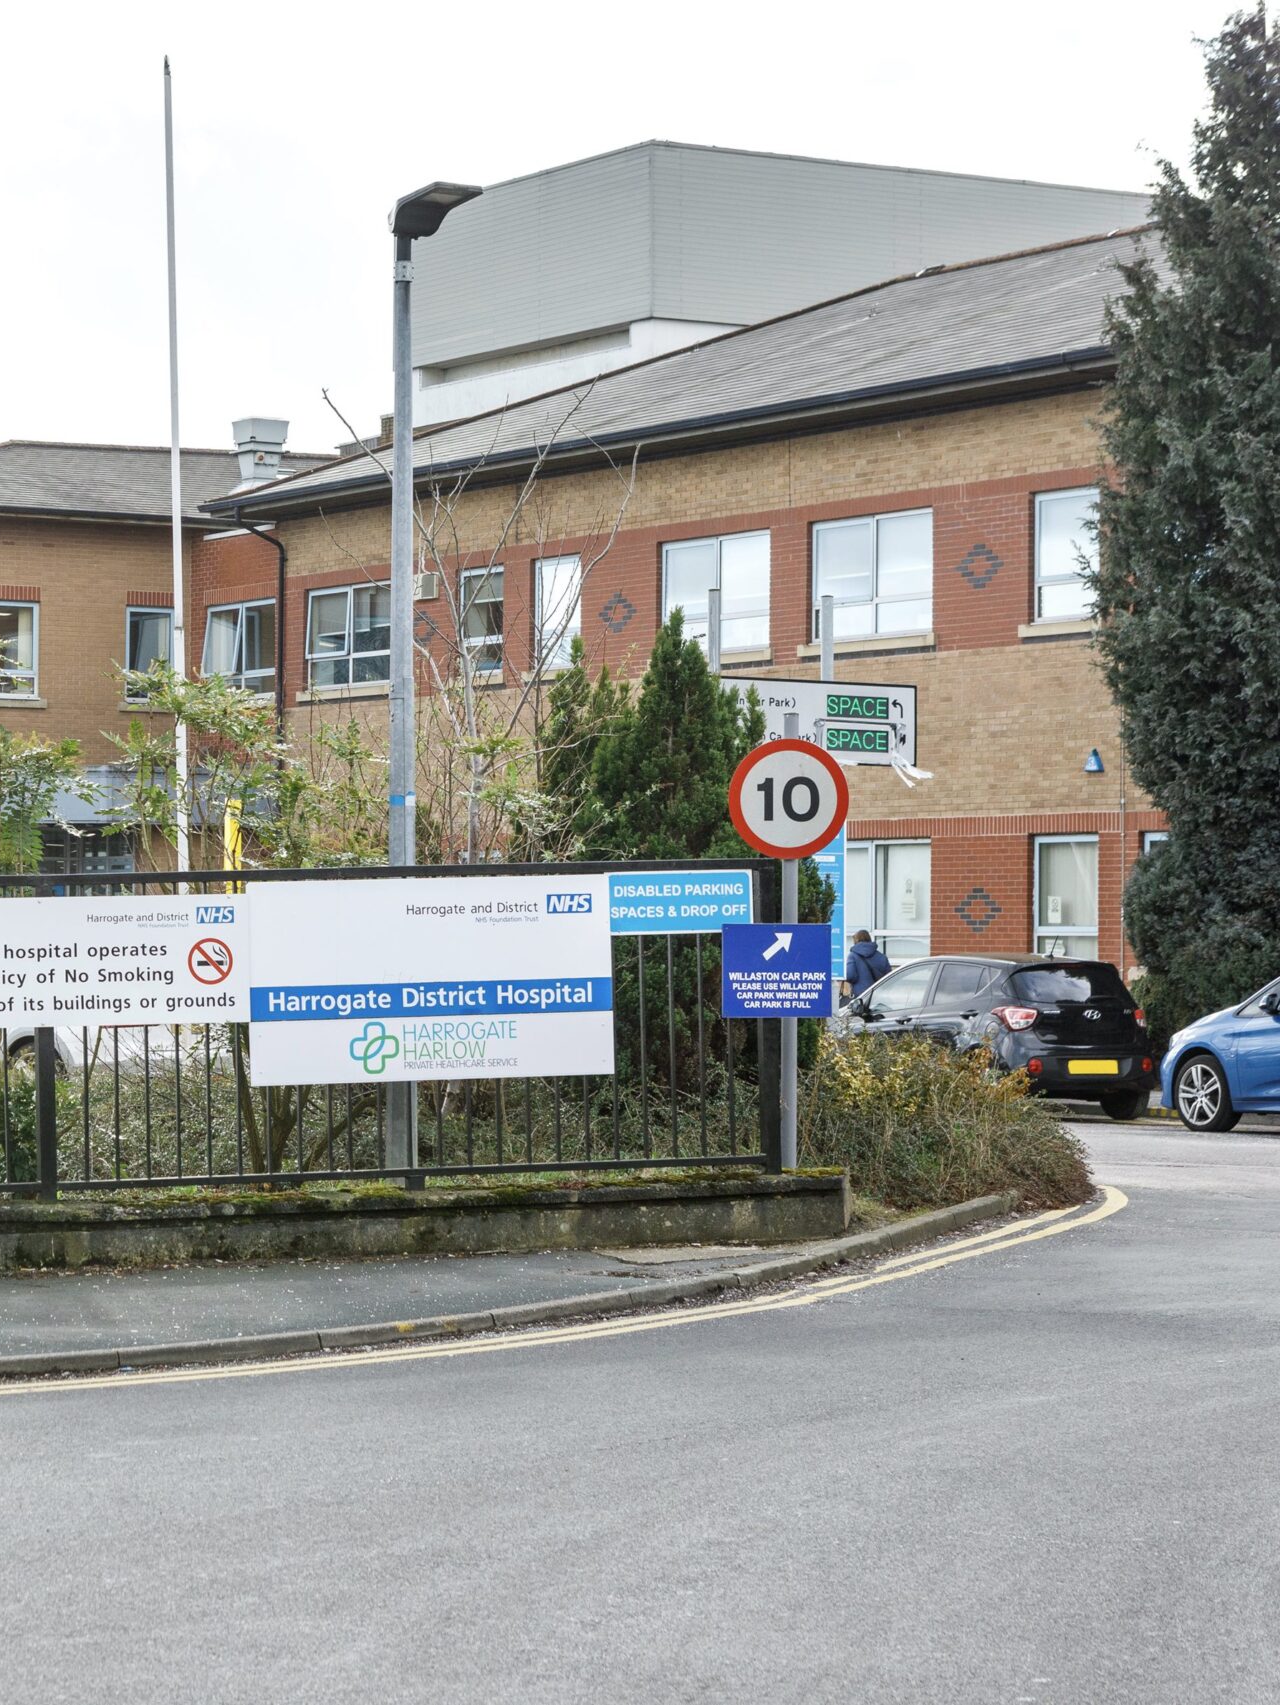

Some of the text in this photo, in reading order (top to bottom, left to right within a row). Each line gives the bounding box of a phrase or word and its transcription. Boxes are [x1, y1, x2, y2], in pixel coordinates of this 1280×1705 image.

[769, 697, 796, 708] Park)
[827, 696, 888, 718] SPACE
[827, 730, 888, 751] SPACE
[756, 776, 820, 823] 10
[614, 884, 743, 897] DISABLED PARKING
[406, 901, 538, 917] Harrogate and District
[547, 894, 592, 913] NHS
[611, 904, 747, 919] SPACES & DROP OFF
[86, 912, 189, 925] Harrogate and District
[197, 906, 234, 923] NHS
[4, 943, 78, 962] hospital
[87, 943, 168, 961] operates
[36, 969, 55, 985] of
[65, 969, 89, 984] No
[98, 967, 174, 985] Smoking
[729, 972, 826, 981] WILLASTON CAR PARK
[23, 996, 44, 1011] its
[53, 994, 131, 1013] buildings
[140, 997, 157, 1009] or
[166, 992, 236, 1010] grounds
[269, 982, 593, 1016] Harrogate District Hospital
[402, 1021, 518, 1041] HARROGATE
[403, 1041, 486, 1061] HARLOW
[404, 1058, 518, 1070] PRIVATE HEALTHCARE SERVICE
